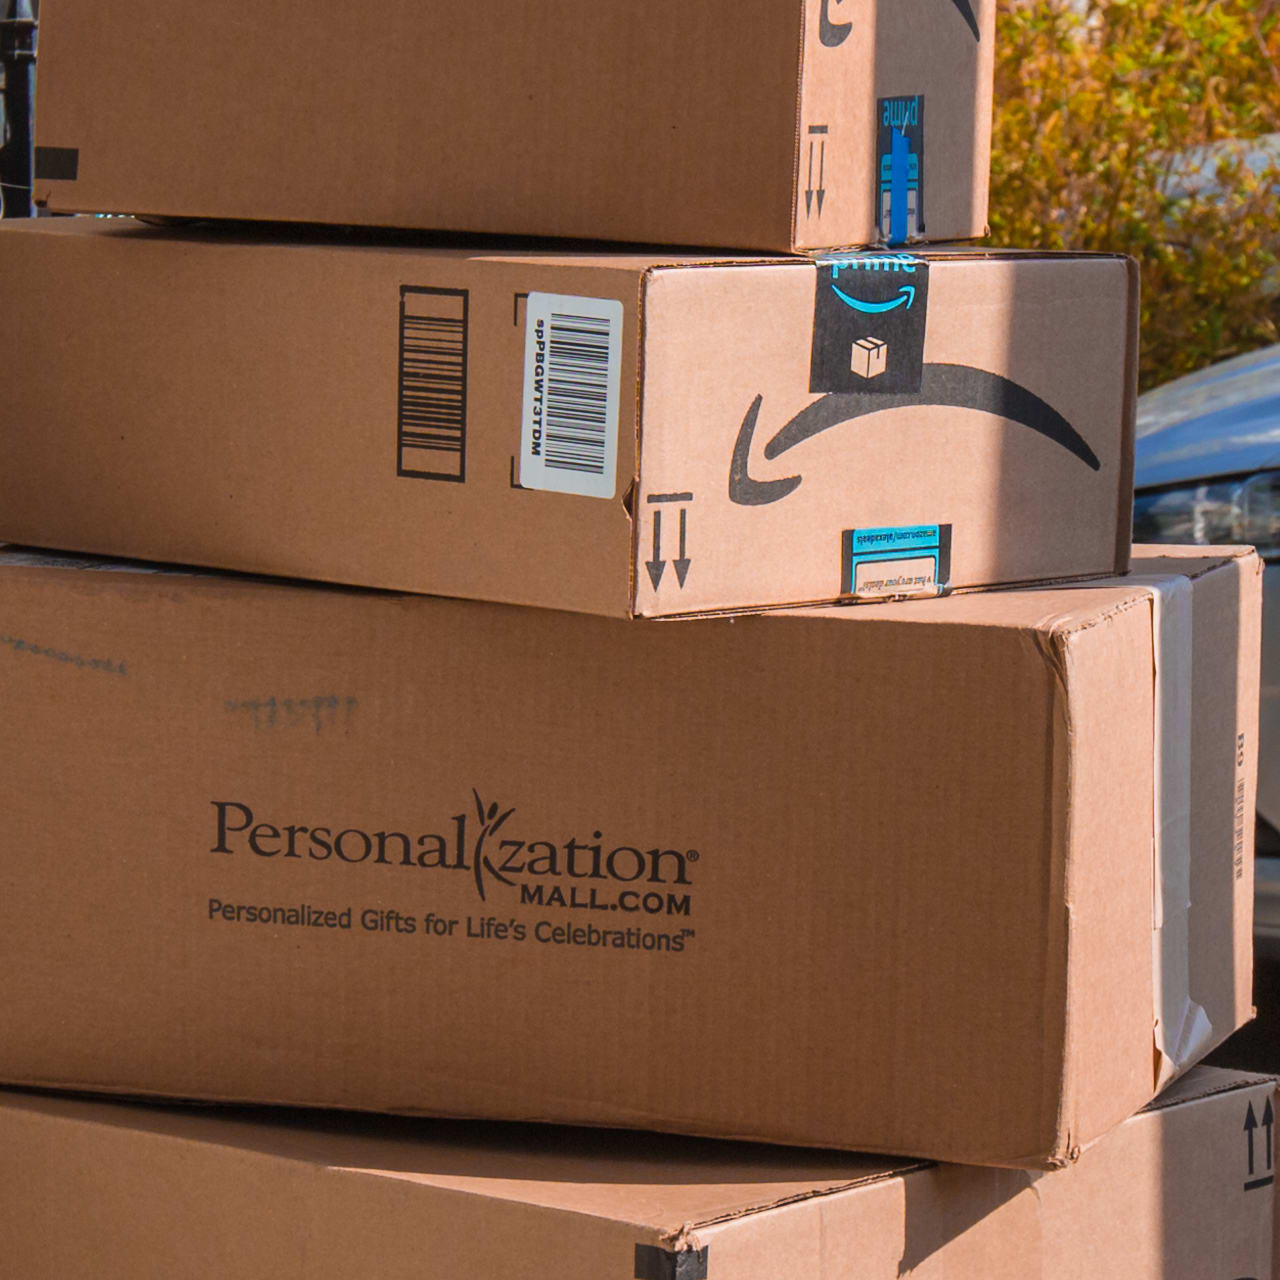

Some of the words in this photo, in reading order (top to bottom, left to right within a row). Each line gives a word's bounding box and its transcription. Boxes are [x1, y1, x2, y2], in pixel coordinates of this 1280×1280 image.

[530, 318, 547, 457] spPBGWT3TDM
[208, 898, 353, 929] Personalized
[360, 907, 417, 935] Gifts
[424, 912, 460, 937] for
[466, 915, 527, 942] Life's
[519, 883, 692, 916] MALL.COM
